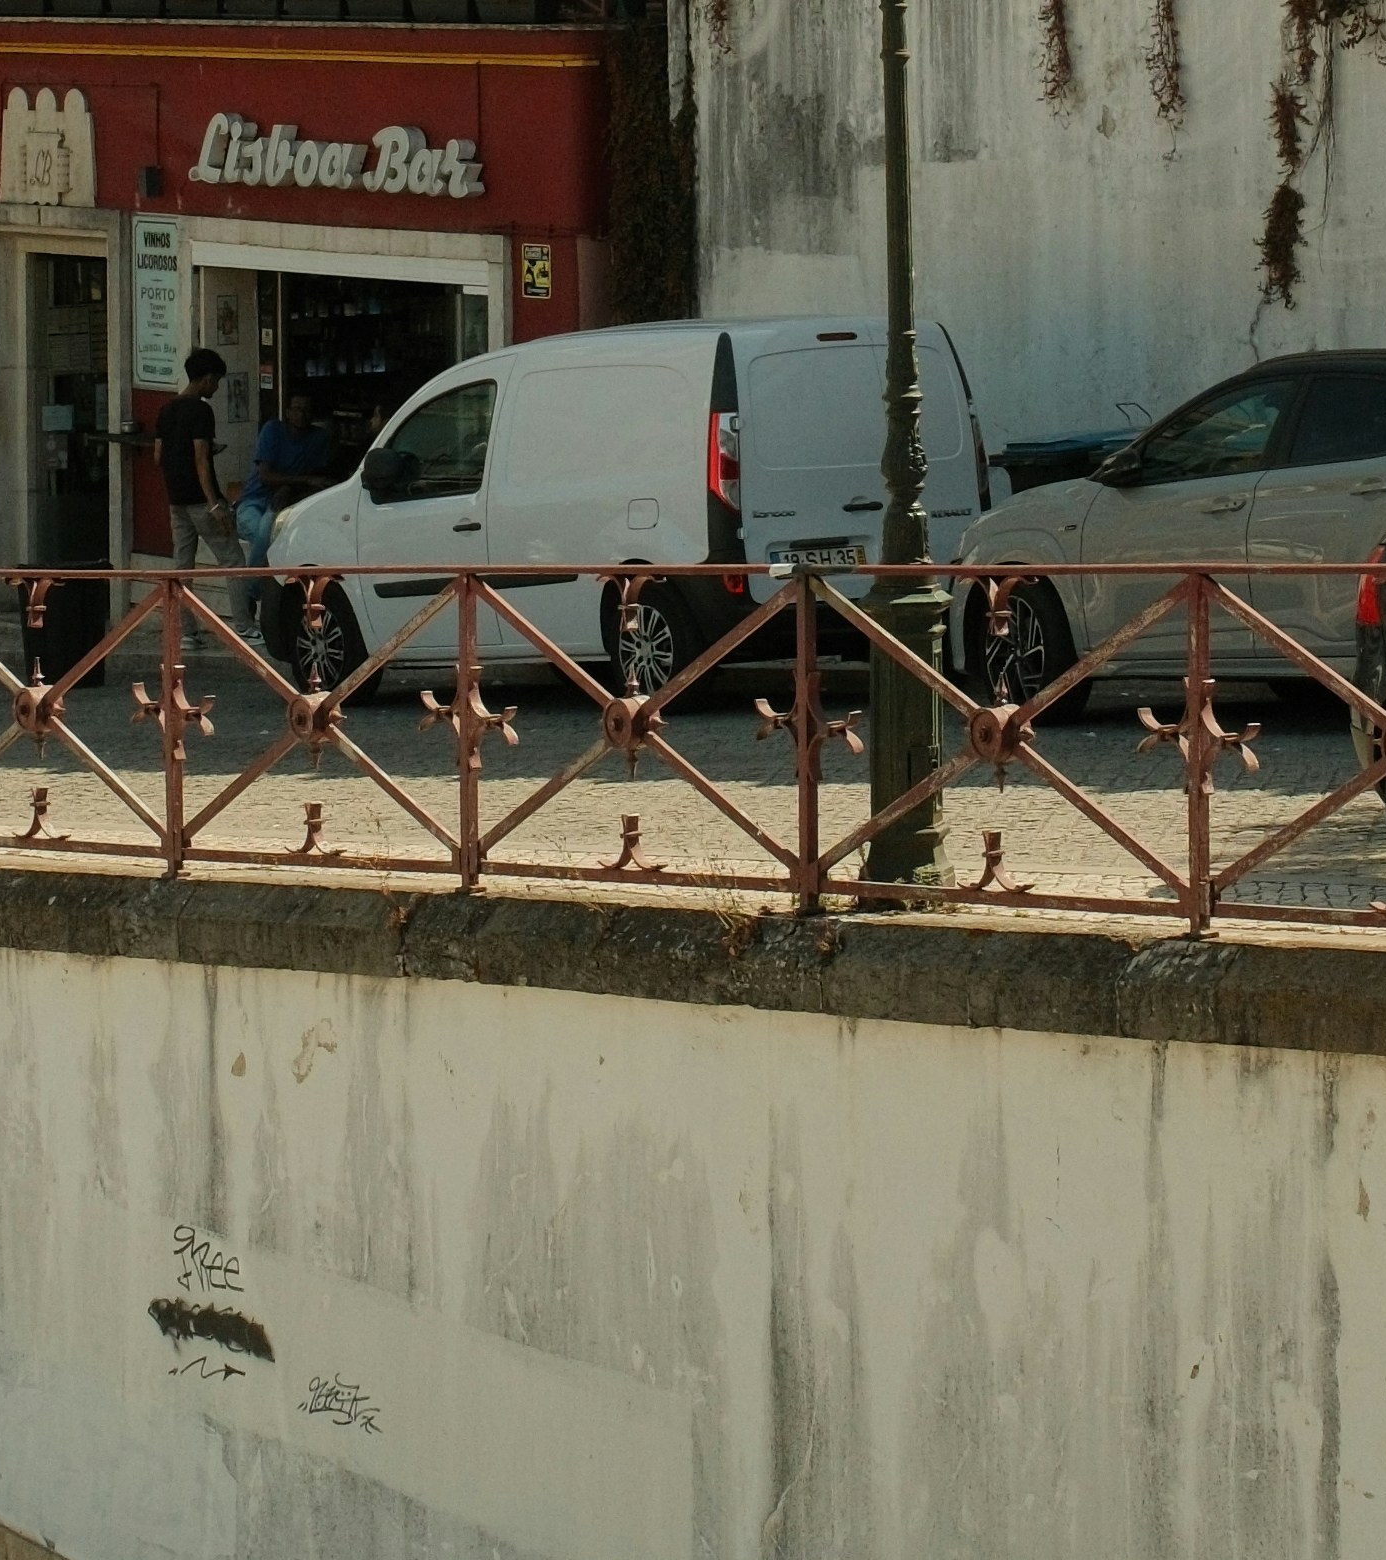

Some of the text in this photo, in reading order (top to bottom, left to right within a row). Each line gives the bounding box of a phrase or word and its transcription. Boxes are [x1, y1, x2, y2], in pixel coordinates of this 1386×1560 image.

[188, 112, 479, 199] Lisboa Bar
[143, 231, 171, 249] VINHOS
[137, 253, 178, 272] LICOROSOS
[140, 286, 176, 302] PORTO
